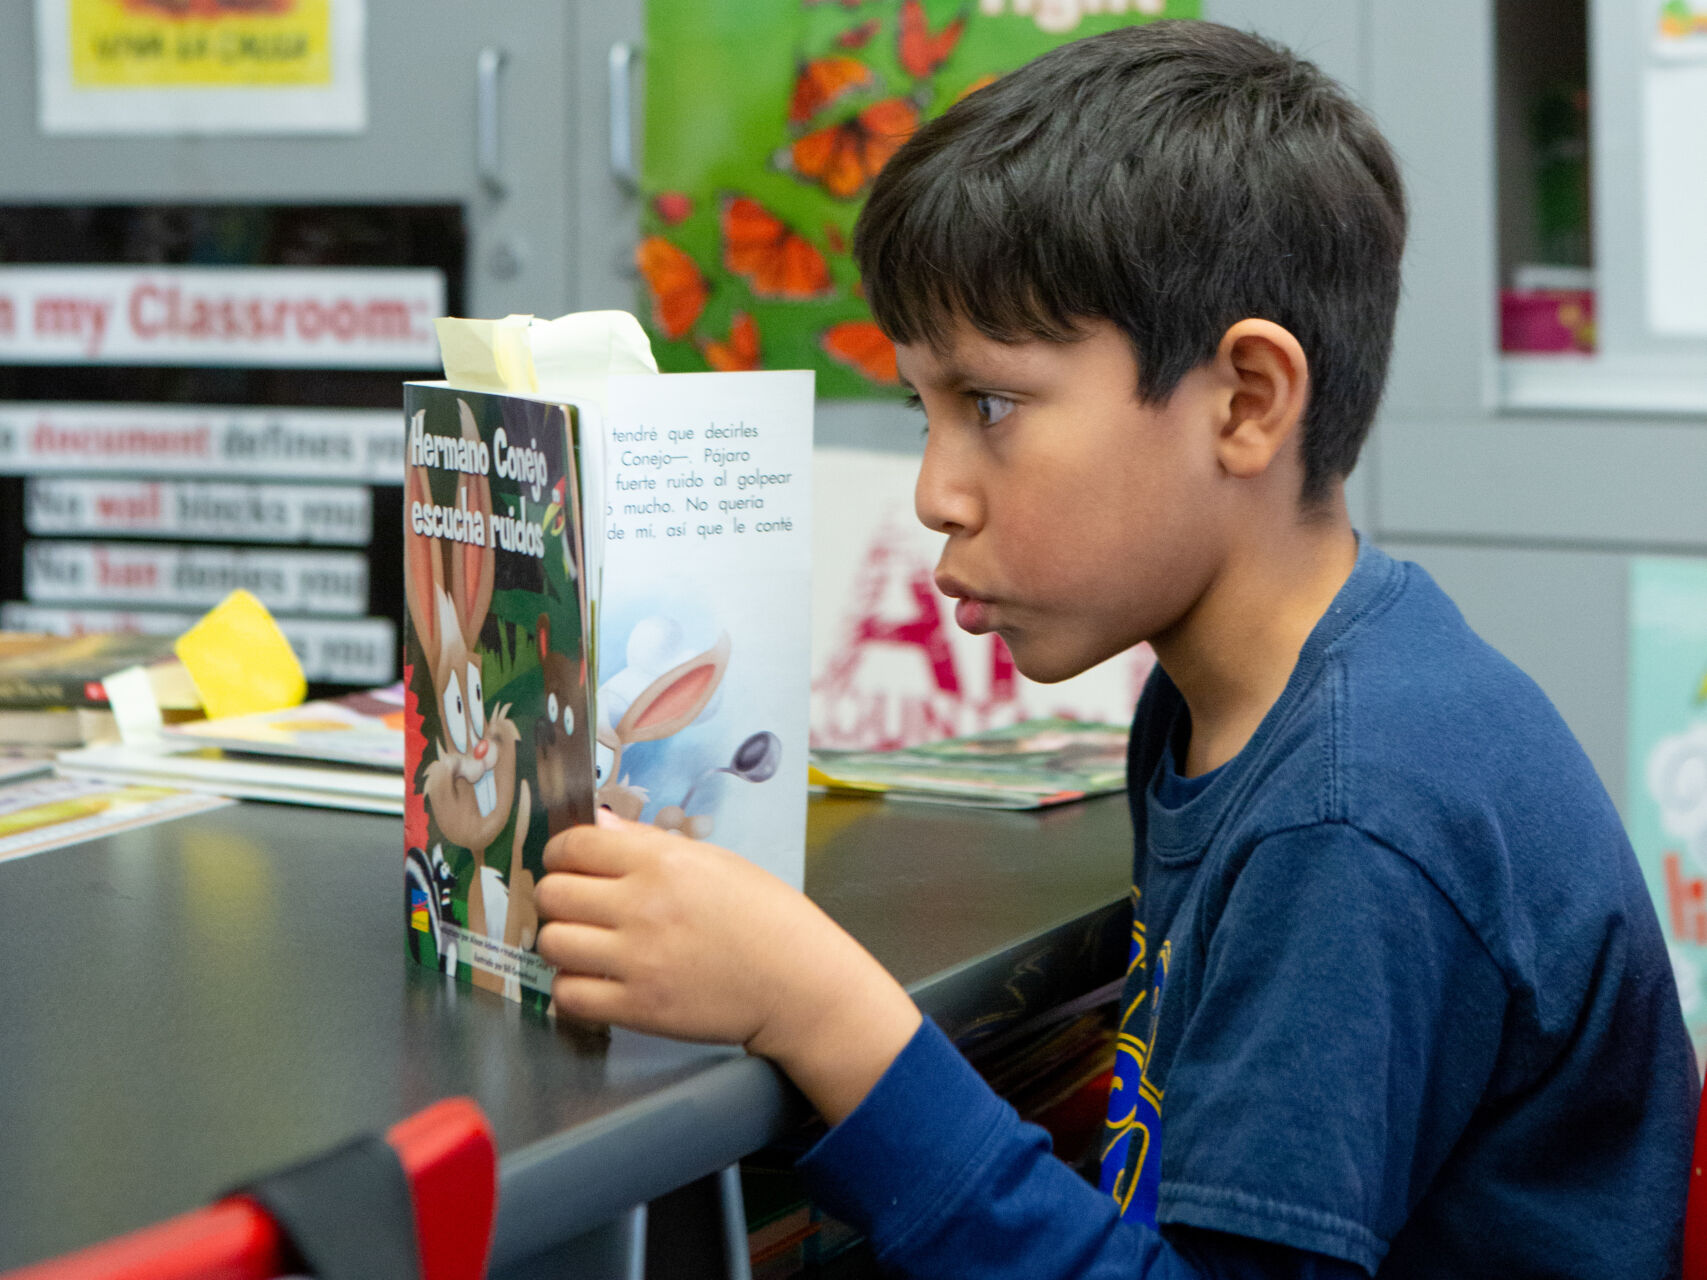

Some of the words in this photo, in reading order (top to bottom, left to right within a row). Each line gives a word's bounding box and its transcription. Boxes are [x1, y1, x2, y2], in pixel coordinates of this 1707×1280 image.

[33, 294, 112, 357] my
[128, 279, 431, 342] Classroom:
[29, 418, 212, 458] document
[223, 422, 353, 462] defines
[611, 423, 658, 443] tendré
[667, 428, 695, 445] que
[704, 421, 760, 440] decirles
[411, 412, 490, 476] Hermano
[493, 426, 548, 503] Conejo
[703, 447, 751, 467] Pájaro
[615, 472, 657, 491] fuerte
[666, 470, 705, 489] ruido
[713, 469, 728, 487] al
[736, 467, 793, 490] golpear
[95, 482, 161, 518] wall
[685, 496, 709, 513] No
[412, 486, 485, 547] escucha
[489, 495, 545, 559] ruidos
[606, 522, 625, 540] de
[696, 522, 724, 539] que
[733, 516, 746, 534] le
[754, 515, 794, 533] conté
